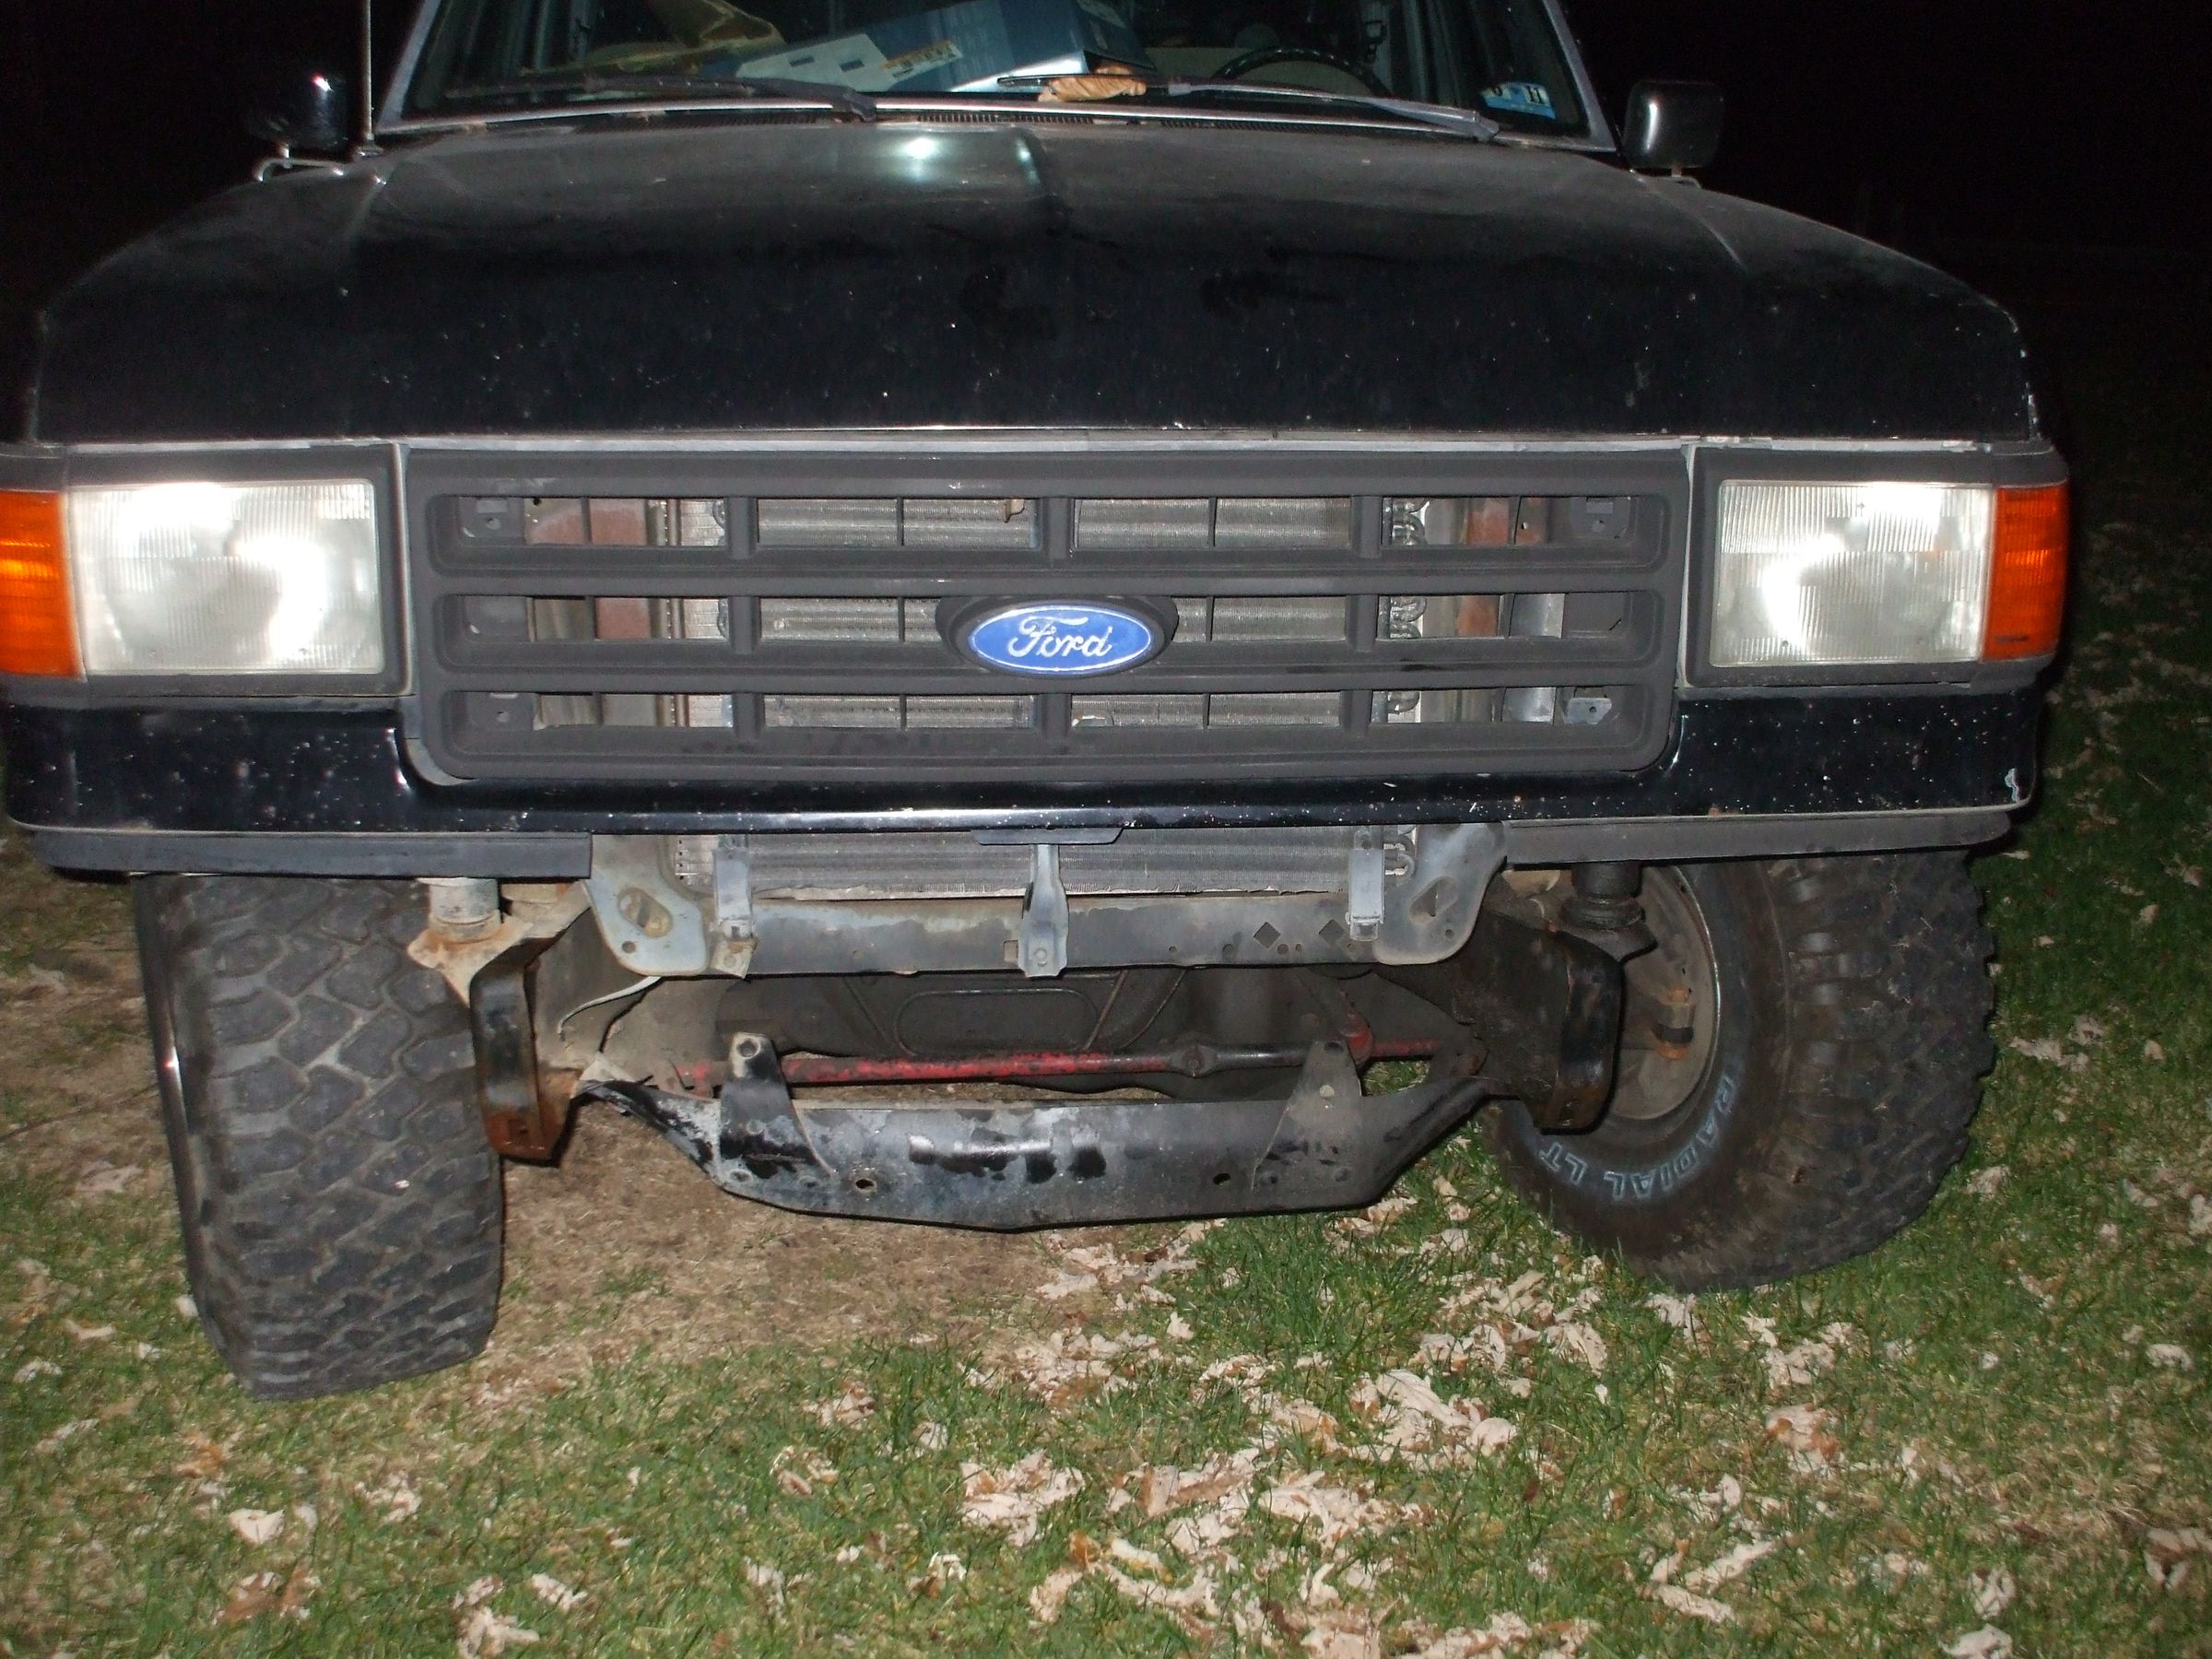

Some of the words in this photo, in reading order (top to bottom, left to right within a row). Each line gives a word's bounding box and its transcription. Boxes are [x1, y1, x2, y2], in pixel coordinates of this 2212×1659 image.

[1006, 615, 1113, 658] Ford
[1603, 1074, 1736, 1198] RADIAL
[1539, 1141, 1588, 1186] LT
